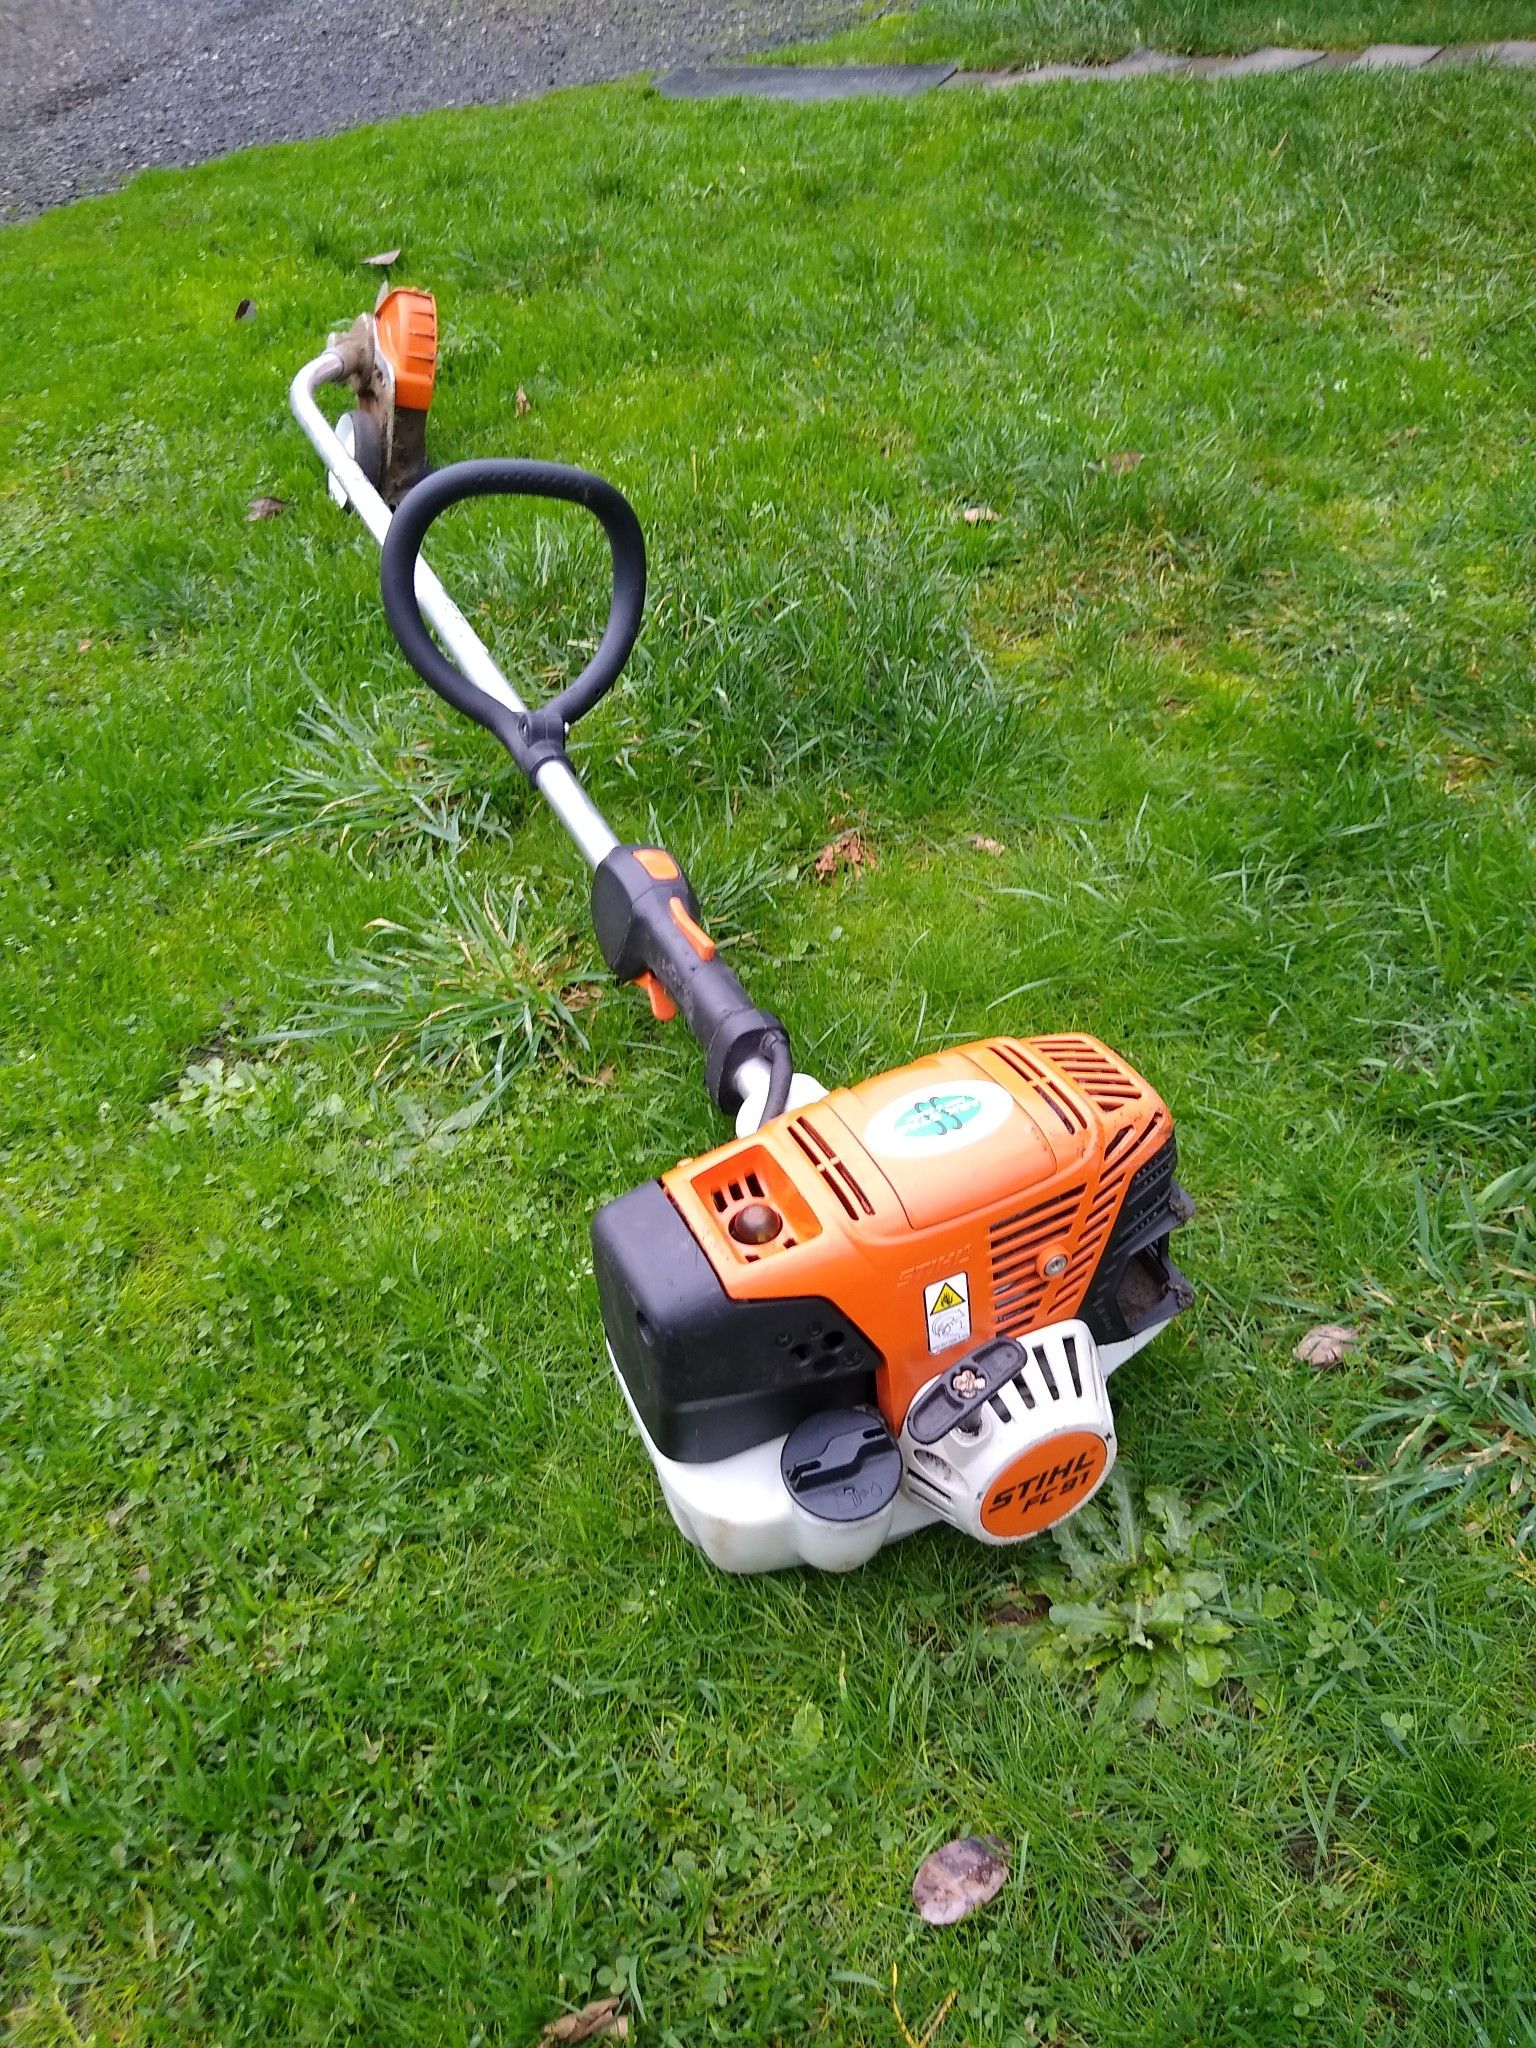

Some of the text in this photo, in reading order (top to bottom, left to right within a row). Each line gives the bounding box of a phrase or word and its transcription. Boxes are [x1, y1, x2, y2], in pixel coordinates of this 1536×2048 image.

[897, 1243, 972, 1288] STIHL
[988, 1452, 1095, 1515] STIHL
[1022, 1471, 1090, 1515] FC 91
